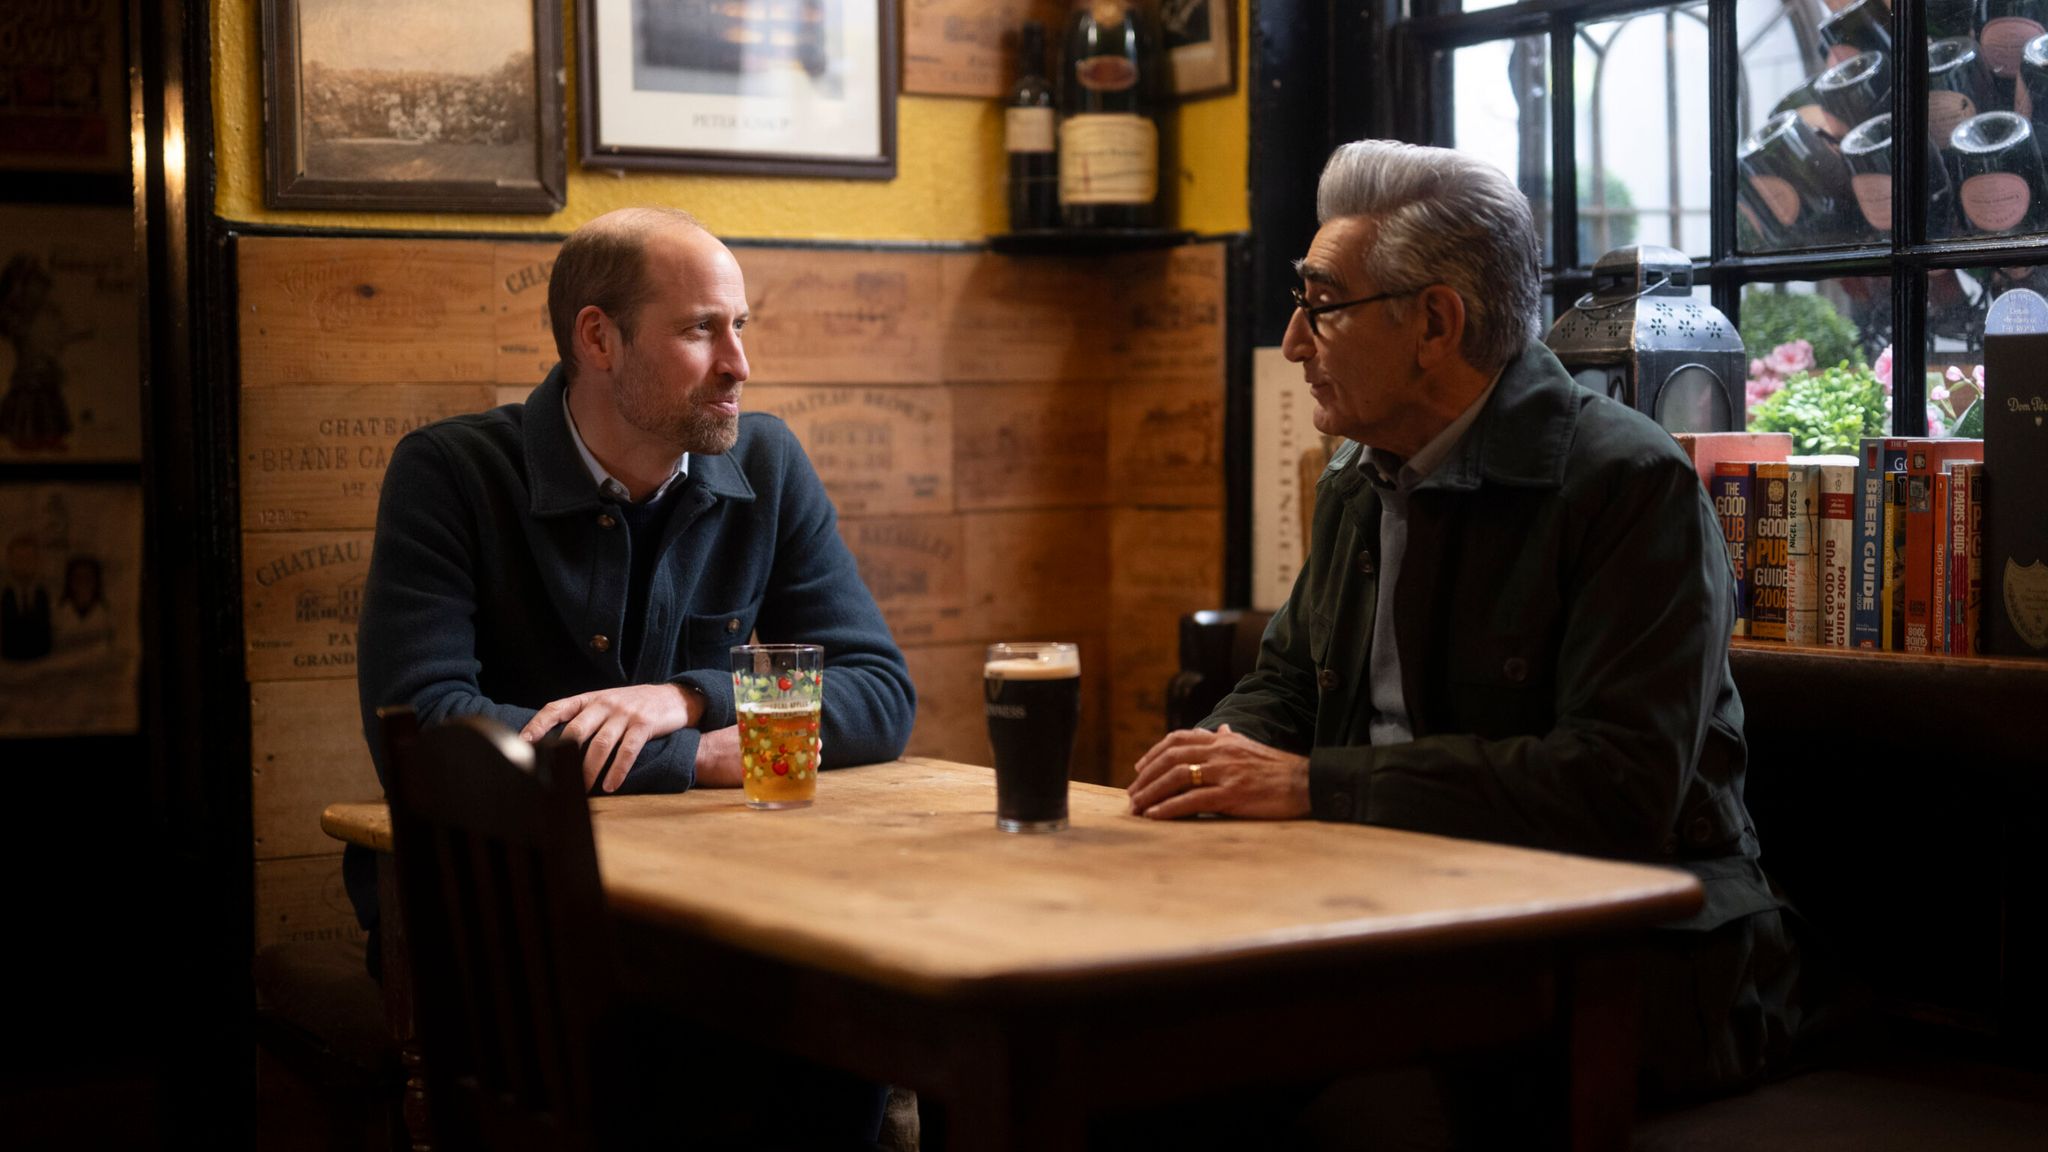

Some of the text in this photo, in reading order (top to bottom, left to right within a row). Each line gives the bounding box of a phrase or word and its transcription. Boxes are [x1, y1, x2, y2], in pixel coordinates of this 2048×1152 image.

[2007, 397, 2031, 412] Dom
[261, 446, 349, 472] BRANE
[1725, 482, 1740, 495] THE
[1715, 496, 1746, 517] GOOD
[1768, 503, 1783, 517] THE
[1789, 489, 1798, 548] NIGEL REES
[1864, 478, 1878, 537] BEER
[1953, 464, 1965, 557] THE PARIS GUIDE
[1758, 518, 1787, 537] GOOD
[256, 540, 361, 588] CHATEAU
[1755, 538, 1787, 566] PUB
[1754, 567, 1787, 588] GUIDE
[1788, 559, 1797, 582] FILE
[1863, 543, 1877, 611] GUIDE
[1755, 589, 1787, 608] 2006
[1824, 539, 1836, 646] THE GOOD PUB
[1837, 565, 1847, 646] GUIDE 2004
[1934, 543, 1944, 642] Amsterdam Guide
